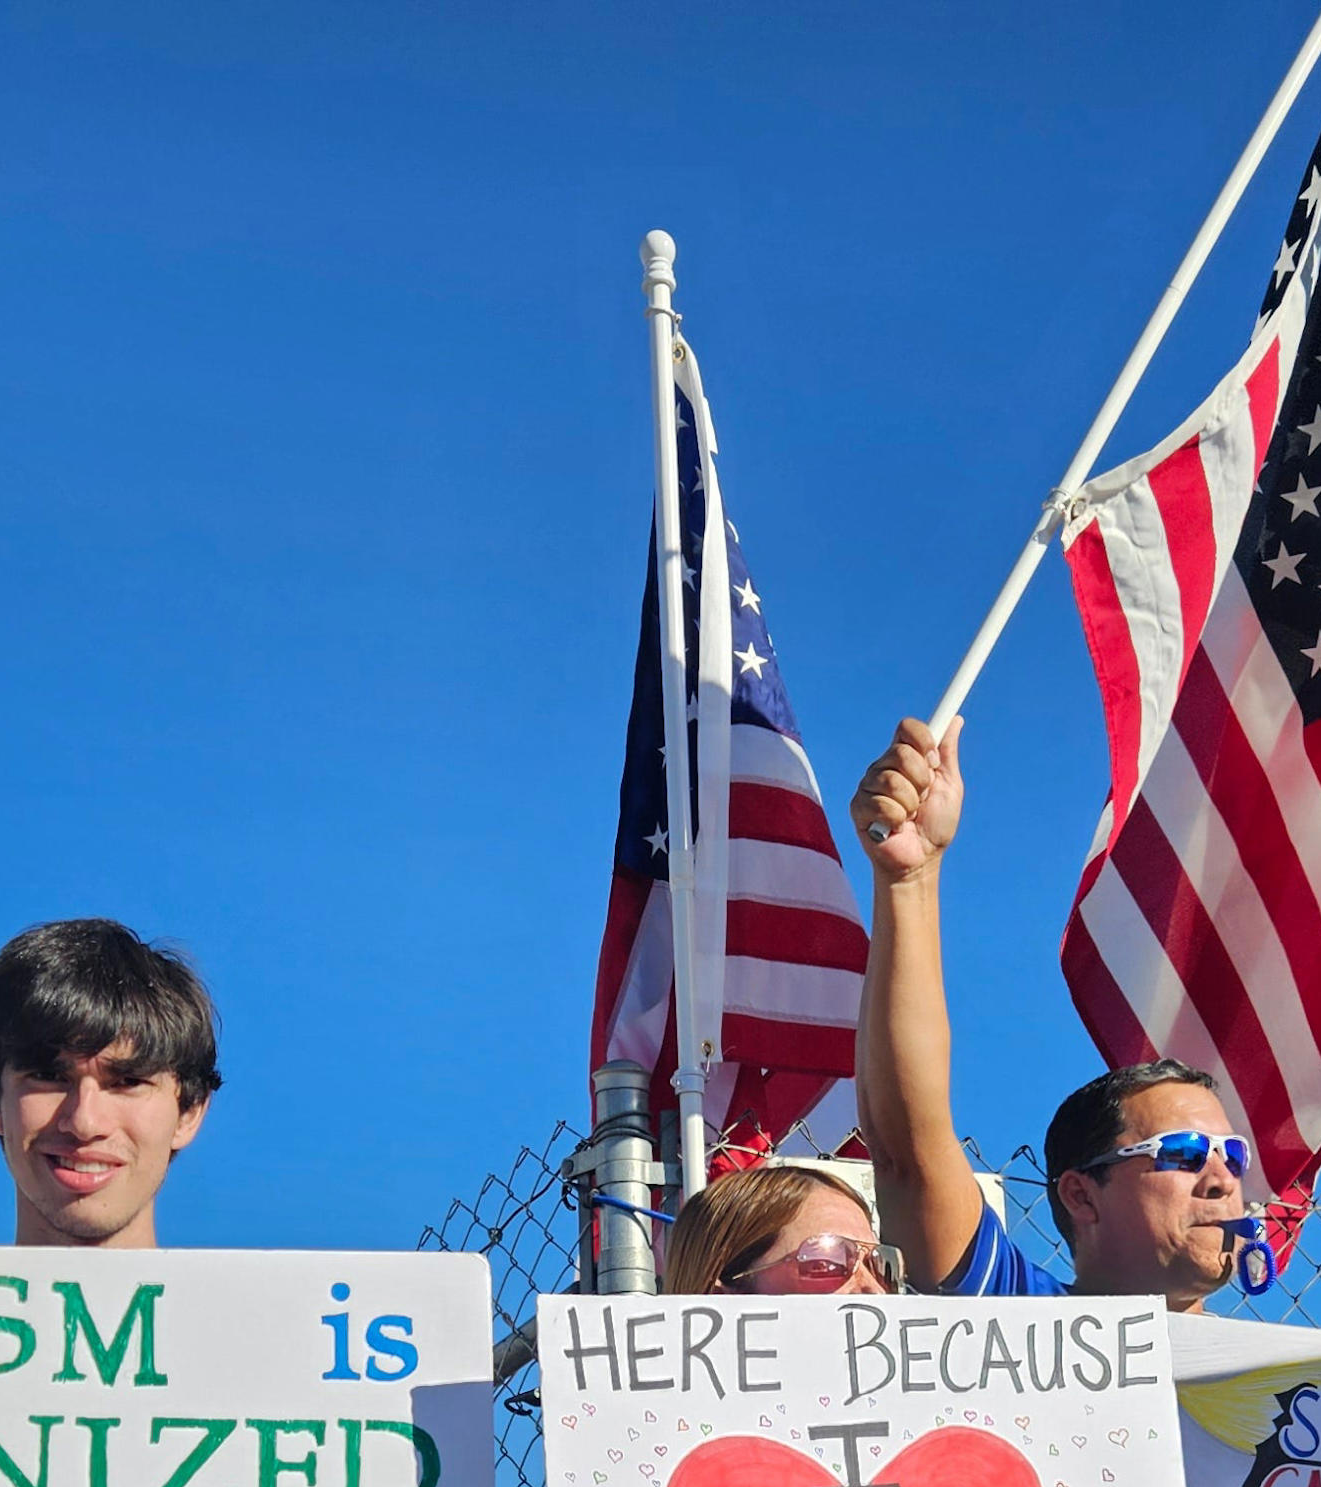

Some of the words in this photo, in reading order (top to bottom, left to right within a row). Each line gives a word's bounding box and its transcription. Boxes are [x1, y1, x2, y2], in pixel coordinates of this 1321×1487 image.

[323, 1283, 420, 1382] is
[563, 1305, 781, 1399] HERE
[837, 1303, 1158, 1406] BECAUSE
